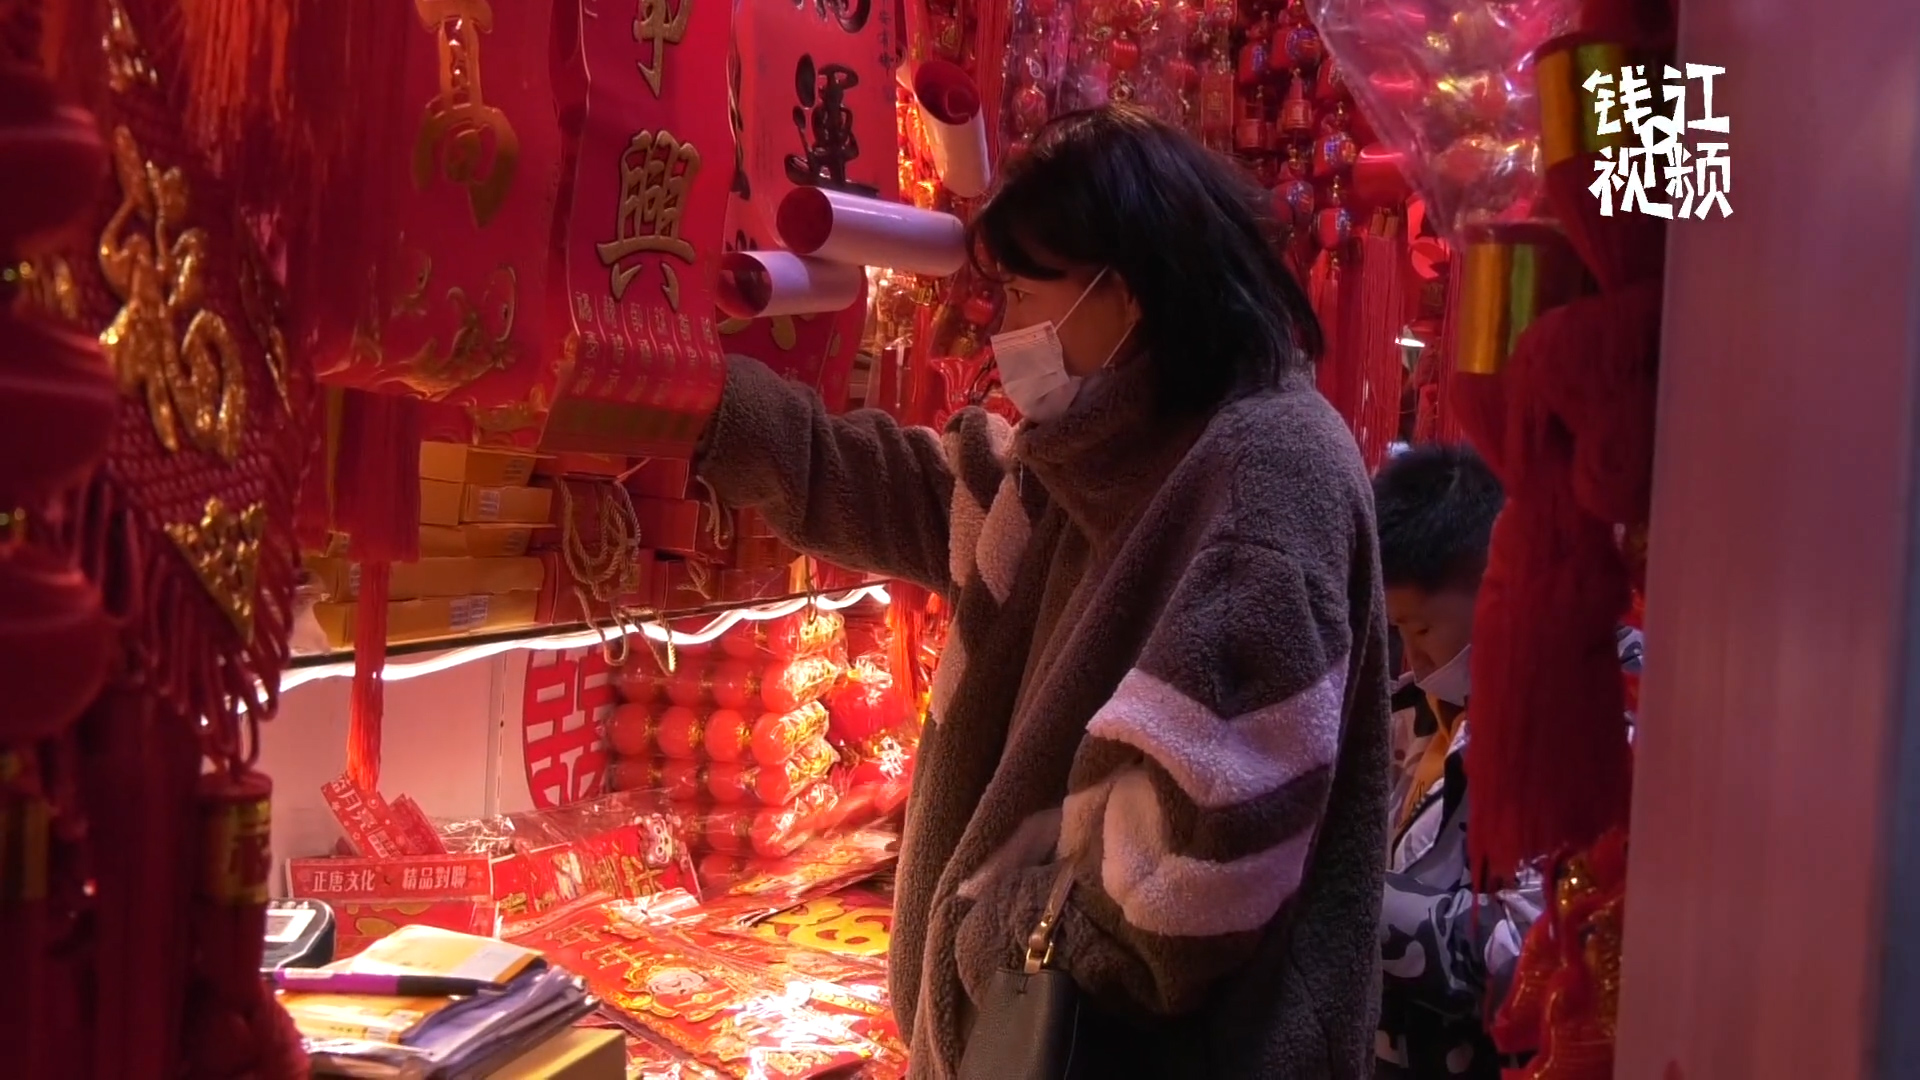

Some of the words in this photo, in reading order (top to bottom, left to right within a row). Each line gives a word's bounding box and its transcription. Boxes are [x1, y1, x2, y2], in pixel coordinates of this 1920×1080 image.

[312, 868, 377, 893] 正唐文化
[402, 865, 467, 891] 精品對聯
